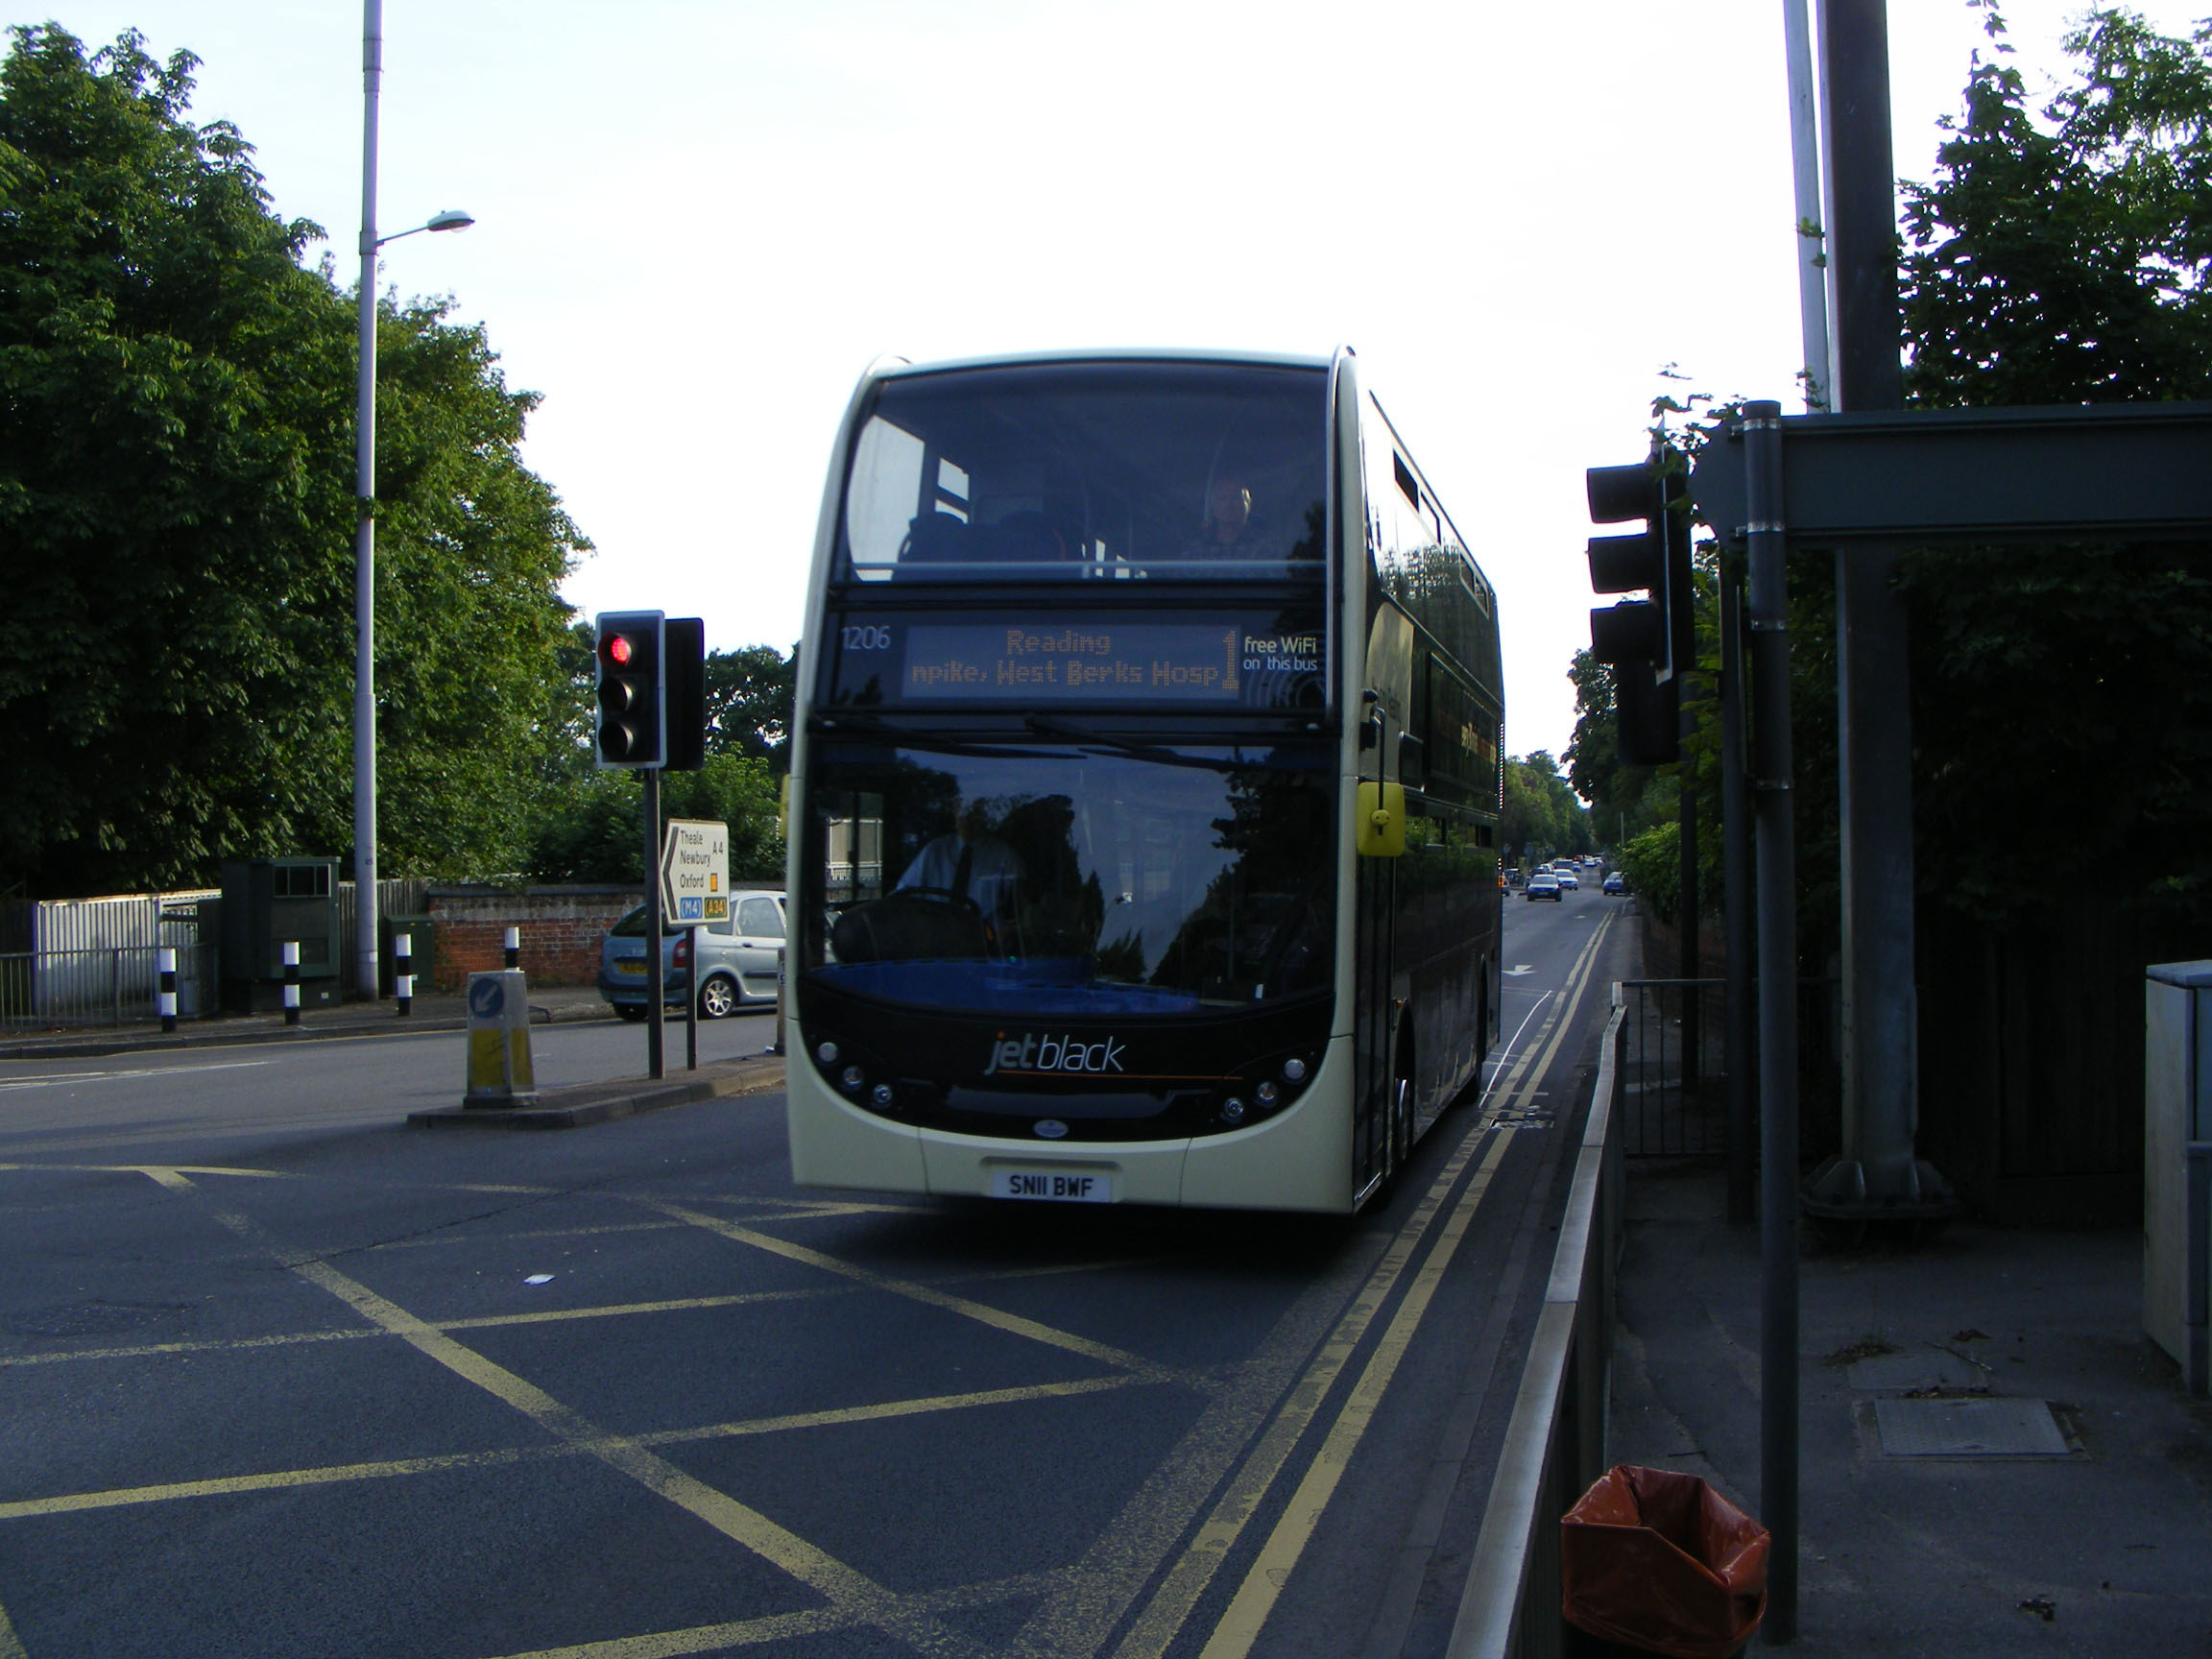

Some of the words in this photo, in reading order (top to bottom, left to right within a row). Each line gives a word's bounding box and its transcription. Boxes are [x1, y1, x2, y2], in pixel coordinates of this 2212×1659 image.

[841, 625, 891, 650] 1206
[1007, 630, 1112, 655] Reading
[1244, 636, 1277, 654] free
[1281, 637, 1316, 654] WiFi
[1221, 630, 1239, 689] 1
[1243, 658, 1261, 670] on
[1267, 656, 1291, 670] this
[1294, 657, 1318, 671] bus
[998, 661, 1057, 685] West
[1068, 661, 1142, 685] Berks
[1152, 661, 1218, 686] Hosp
[681, 830, 703, 845] Theale
[680, 850, 710, 867] Newbury
[680, 874, 705, 888] Oxford
[1009, 1174, 1047, 1195] SN11
[1053, 1177, 1094, 1196] BWF
